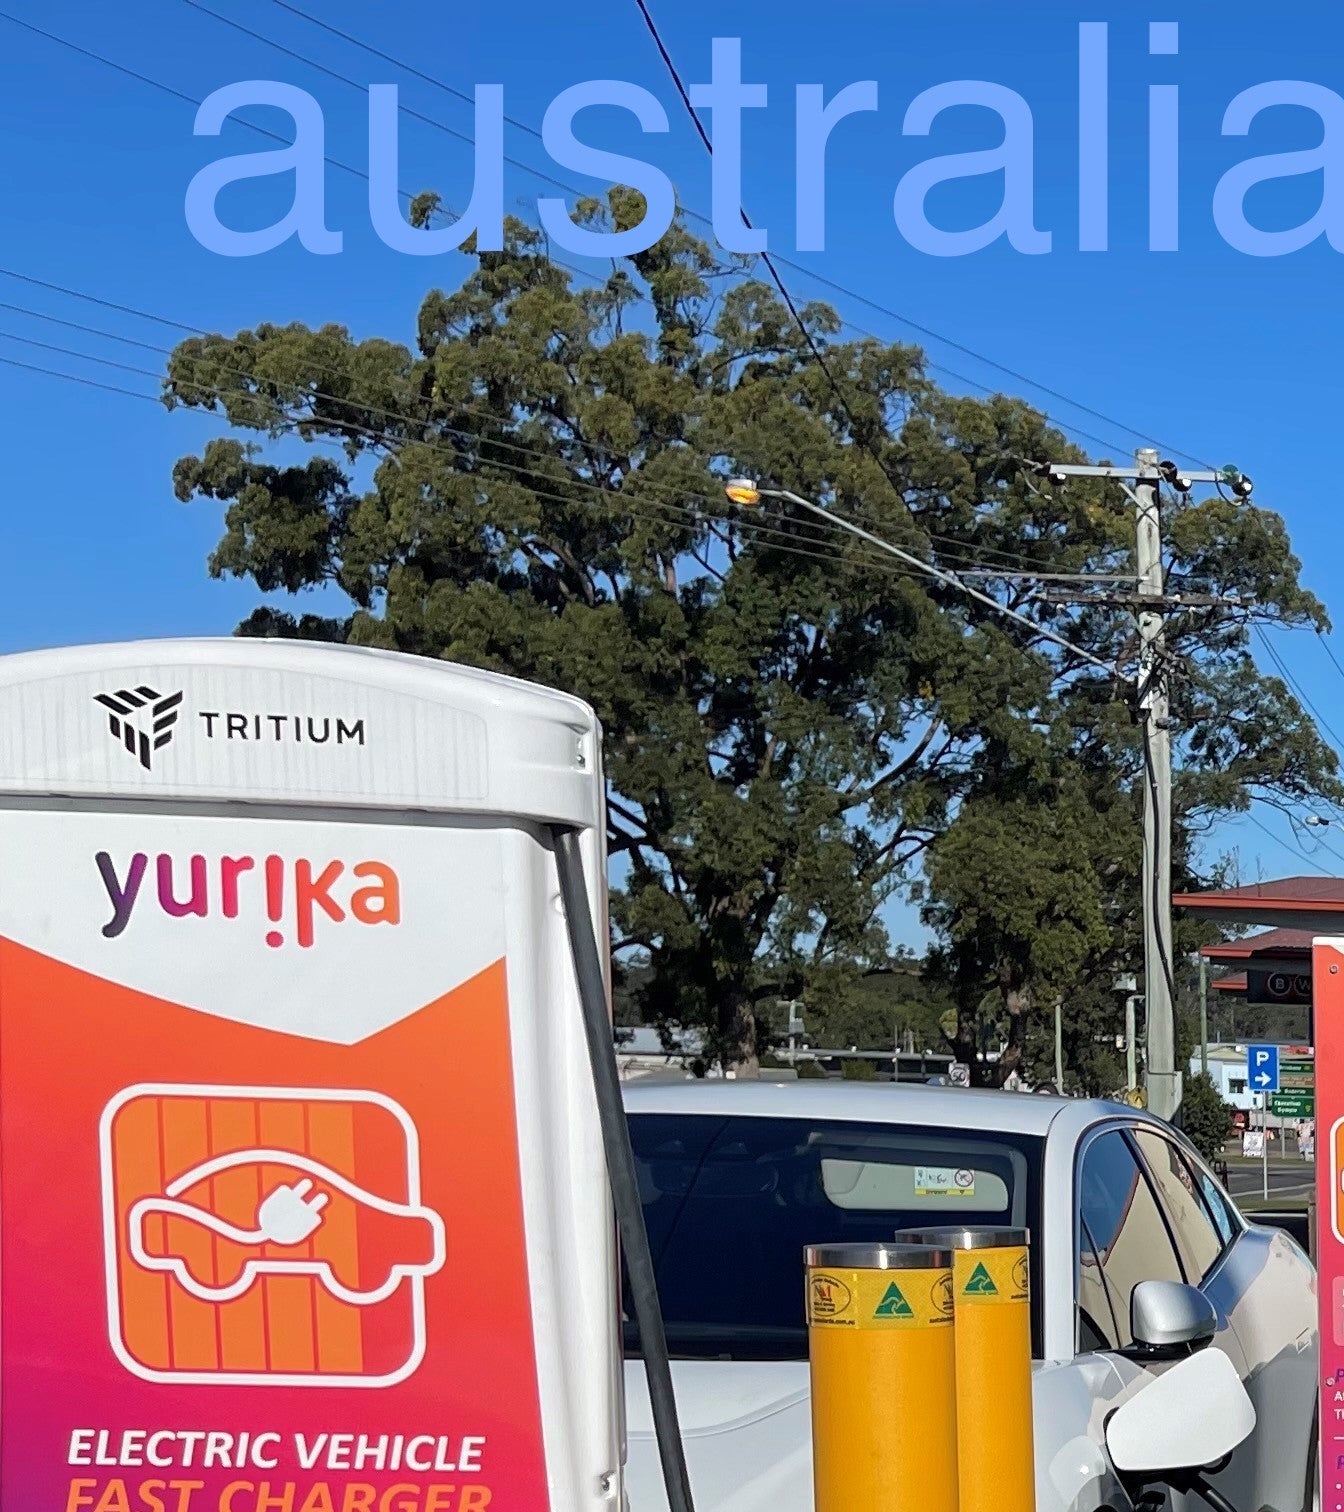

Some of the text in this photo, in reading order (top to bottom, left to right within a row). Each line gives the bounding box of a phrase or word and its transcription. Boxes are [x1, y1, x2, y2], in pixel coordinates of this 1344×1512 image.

[200, 712, 365, 745] TRITIUM
[1256, 1051, 1269, 1066] P
[67, 1429, 486, 1472] ELECTRIC VEHICLE
